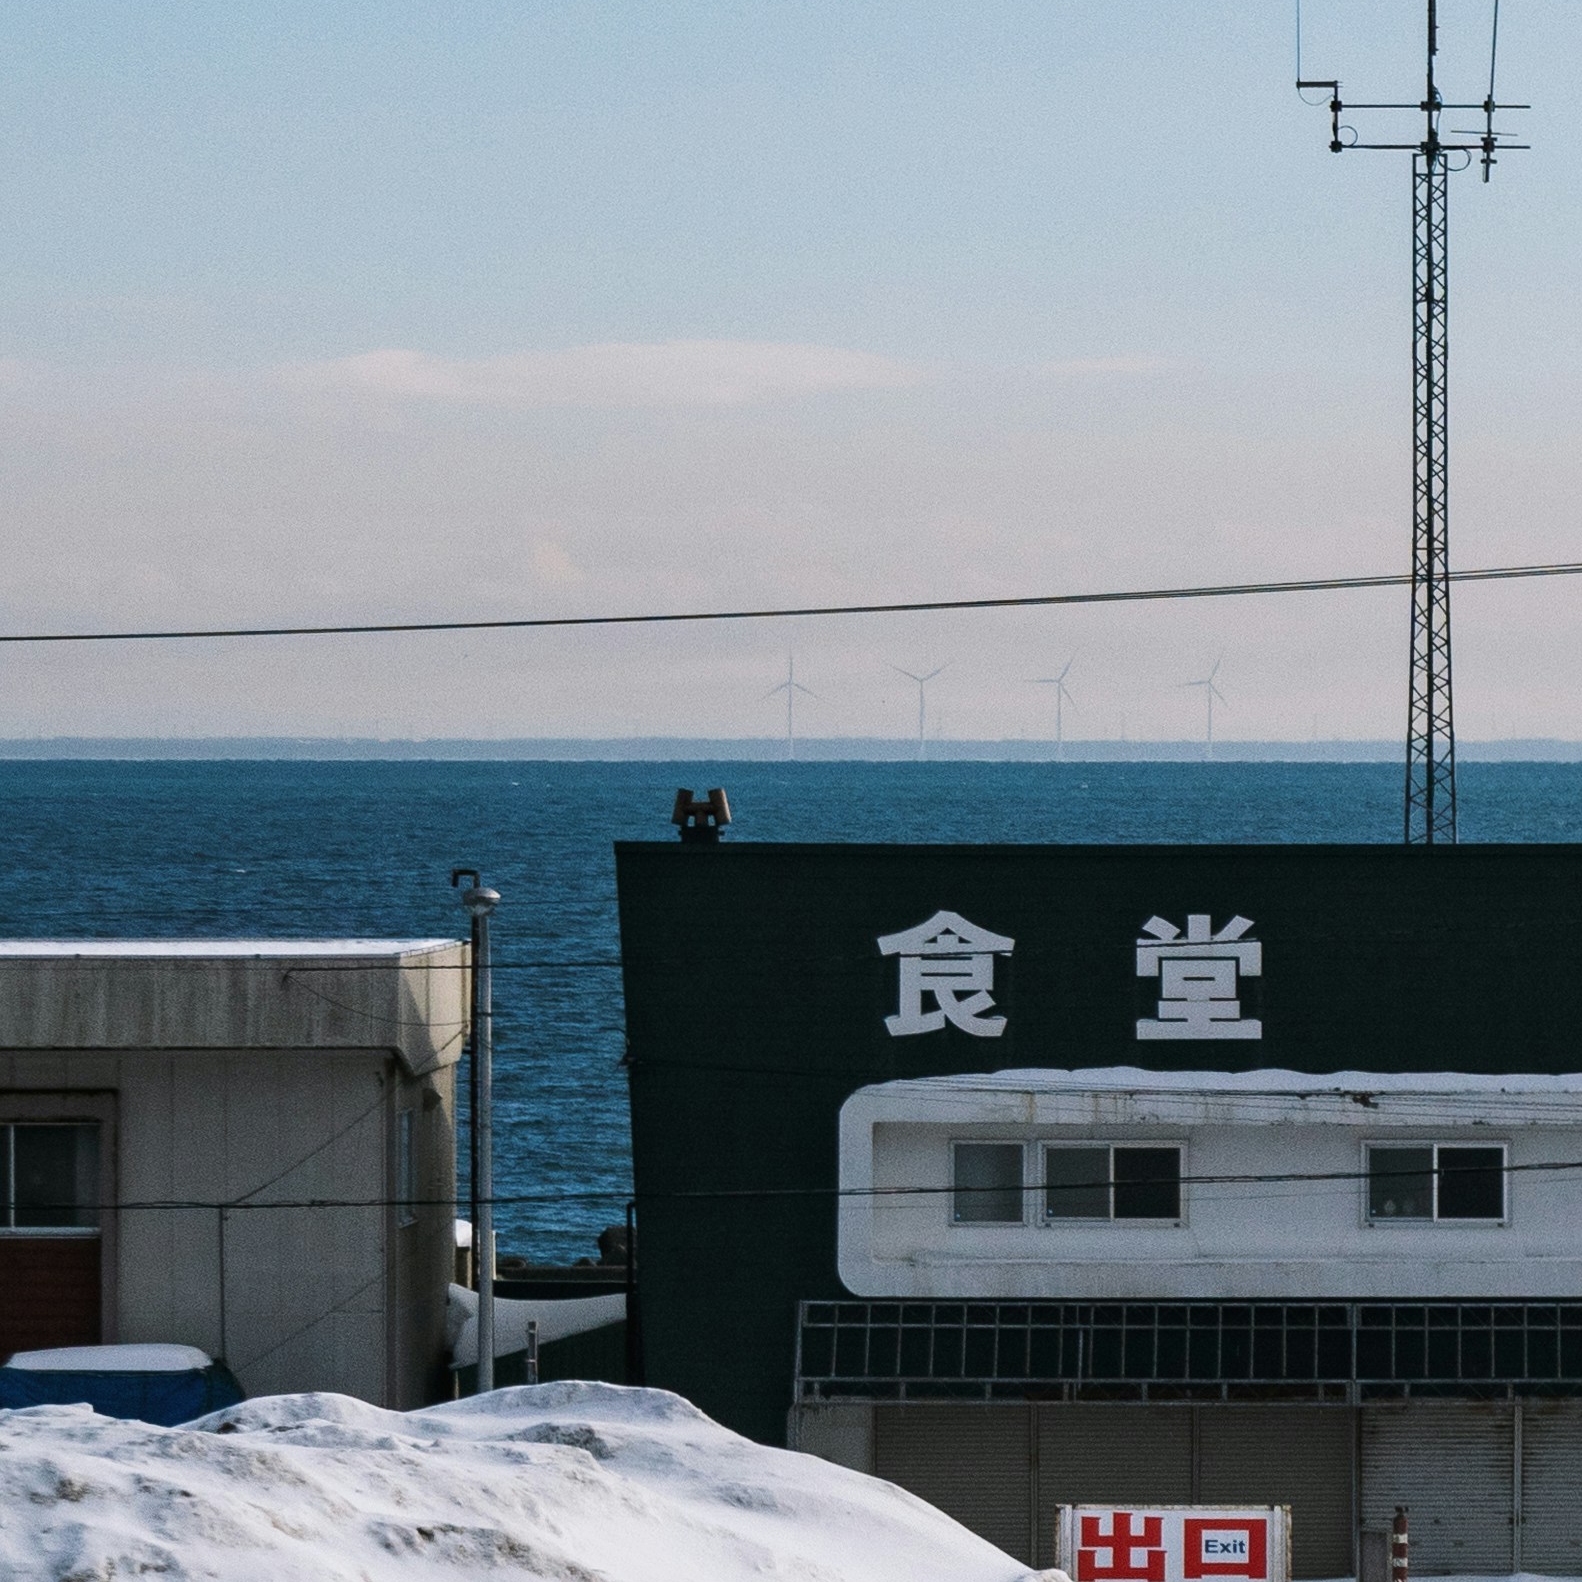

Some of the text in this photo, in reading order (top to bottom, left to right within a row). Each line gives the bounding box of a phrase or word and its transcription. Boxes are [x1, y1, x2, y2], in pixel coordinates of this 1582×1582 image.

[877, 910, 1262, 1039] 食堂
[1078, 1512, 1267, 1582] 出口
[1204, 1539, 1246, 1554] Exit
